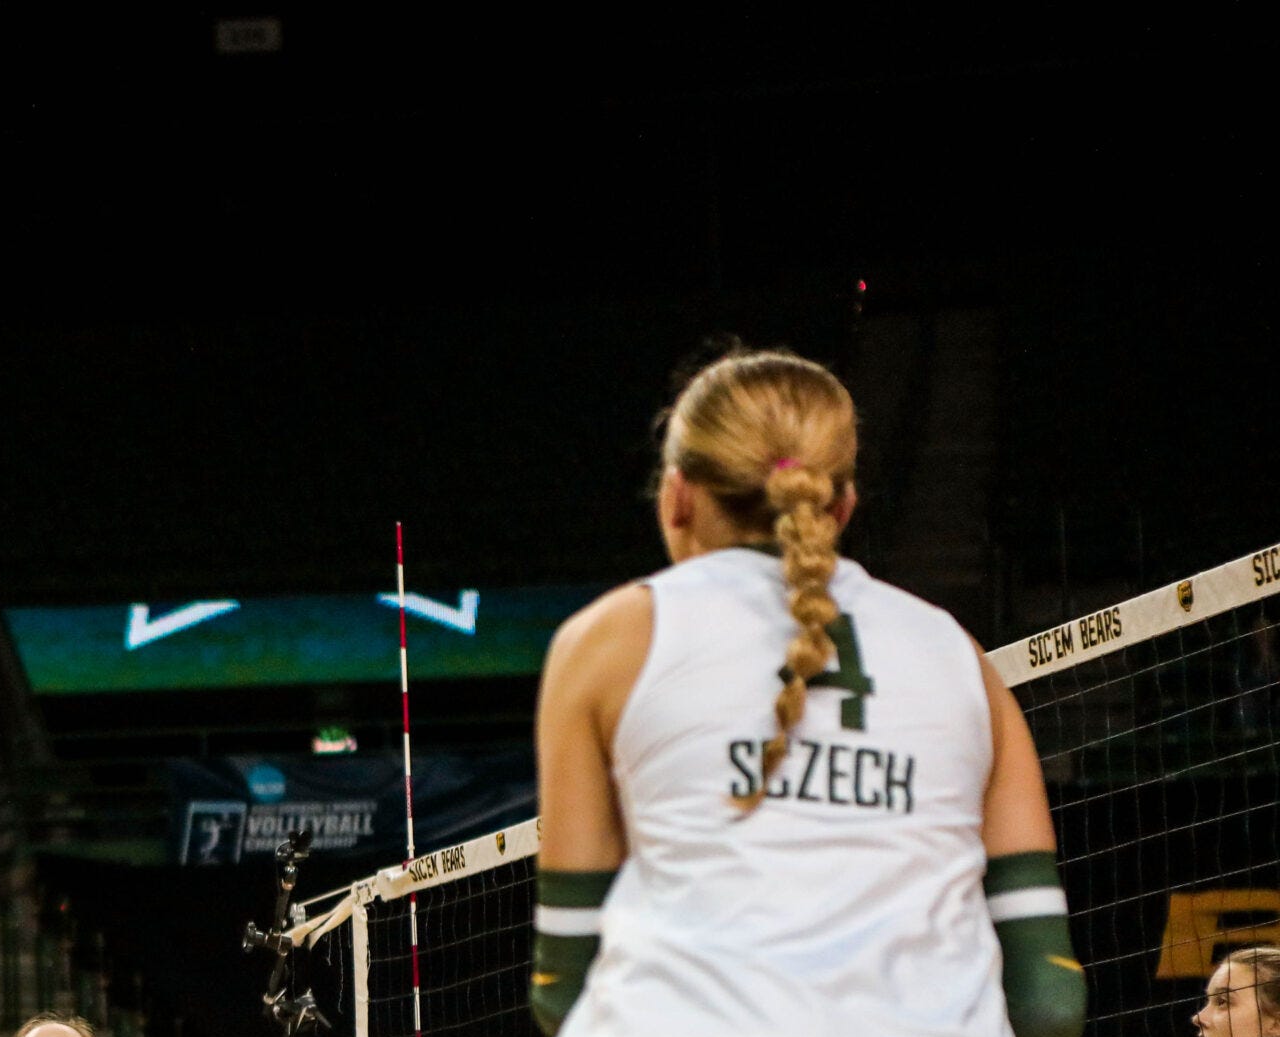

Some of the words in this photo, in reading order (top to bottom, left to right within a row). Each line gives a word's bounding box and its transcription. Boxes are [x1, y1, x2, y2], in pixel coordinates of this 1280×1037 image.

[1028, 623, 1074, 668] SIC'EM
[1079, 606, 1123, 650] BEARS
[777, 613, 875, 732] 4
[441, 845, 466, 873] BEARS
